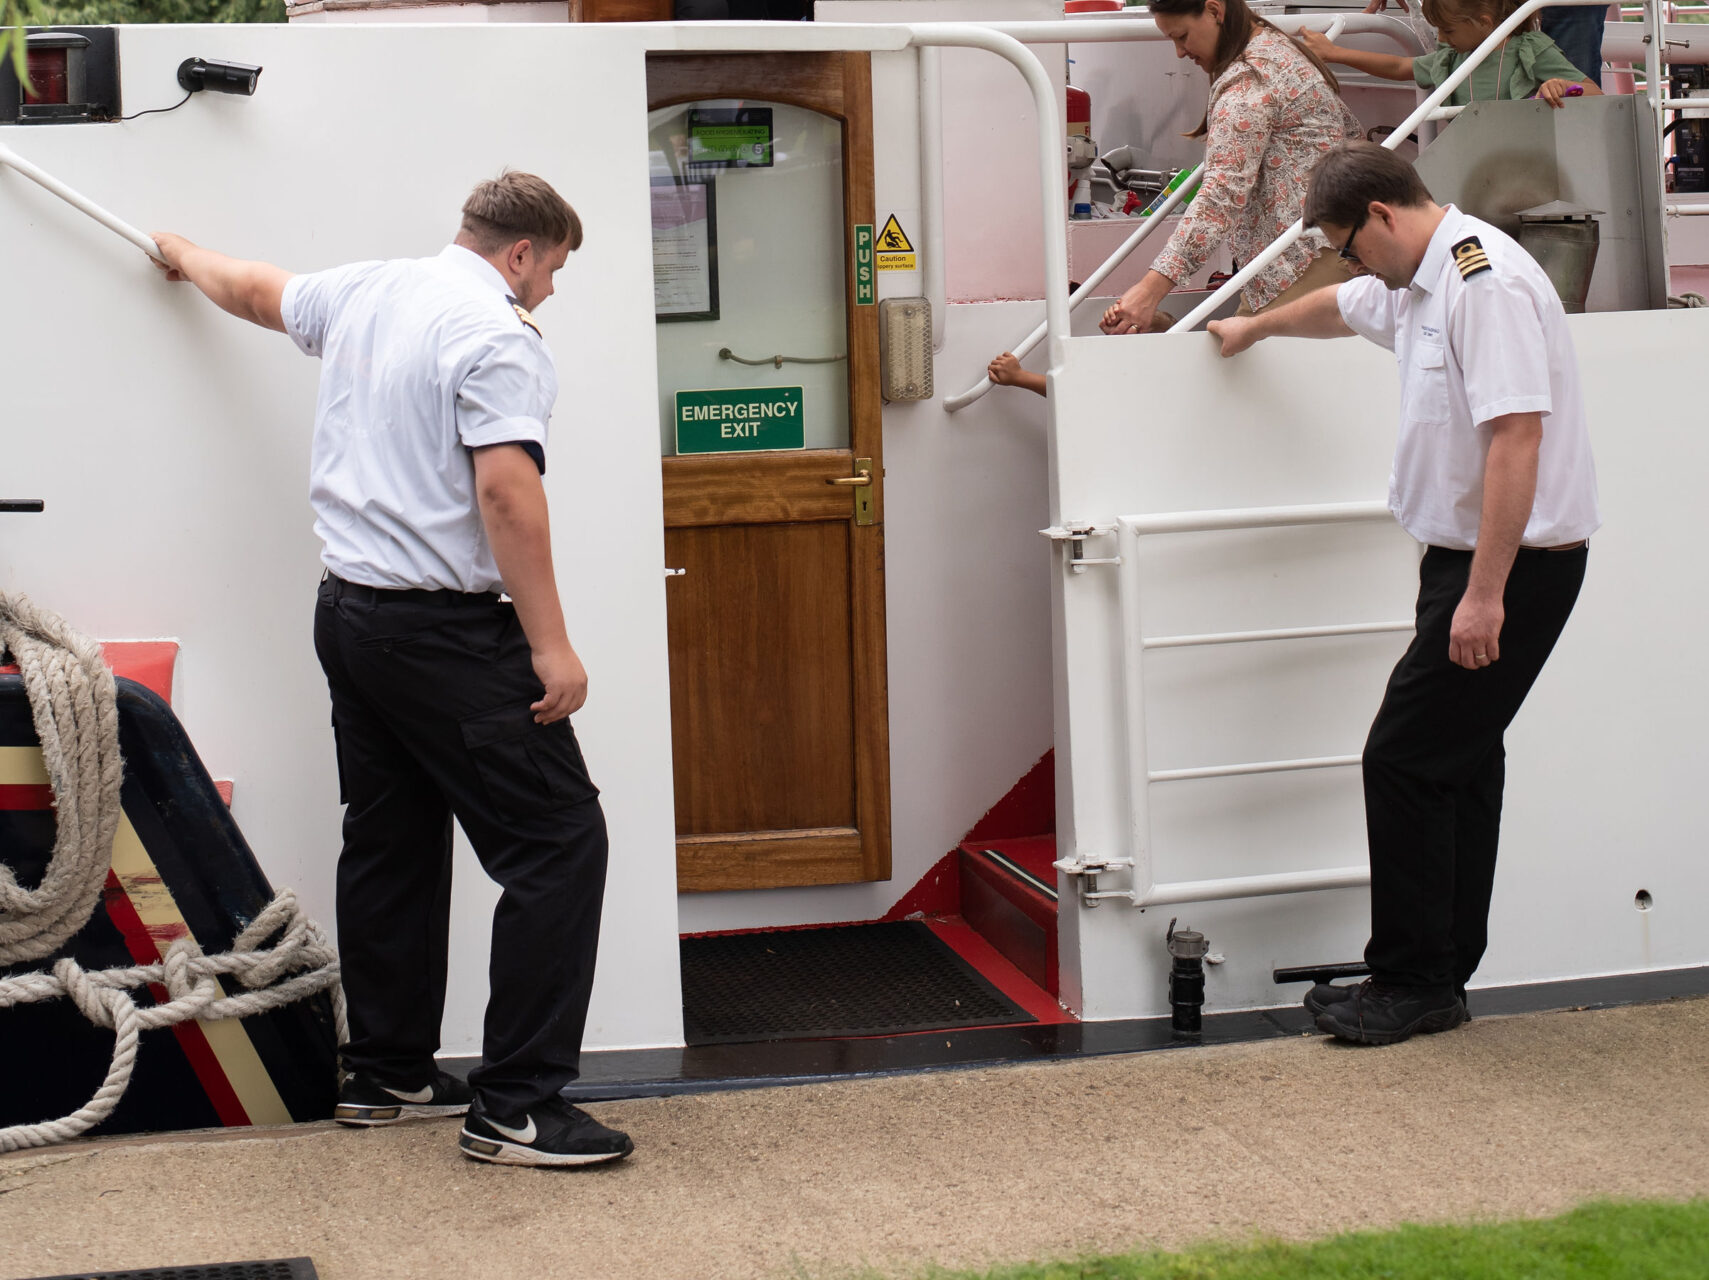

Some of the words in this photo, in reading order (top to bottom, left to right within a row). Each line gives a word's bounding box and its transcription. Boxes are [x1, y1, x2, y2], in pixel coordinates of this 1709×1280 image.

[754, 144, 762, 154] 5
[859, 231, 871, 298] PUSH
[682, 401, 798, 421] EMERGENCY
[721, 421, 761, 438] EXIT
